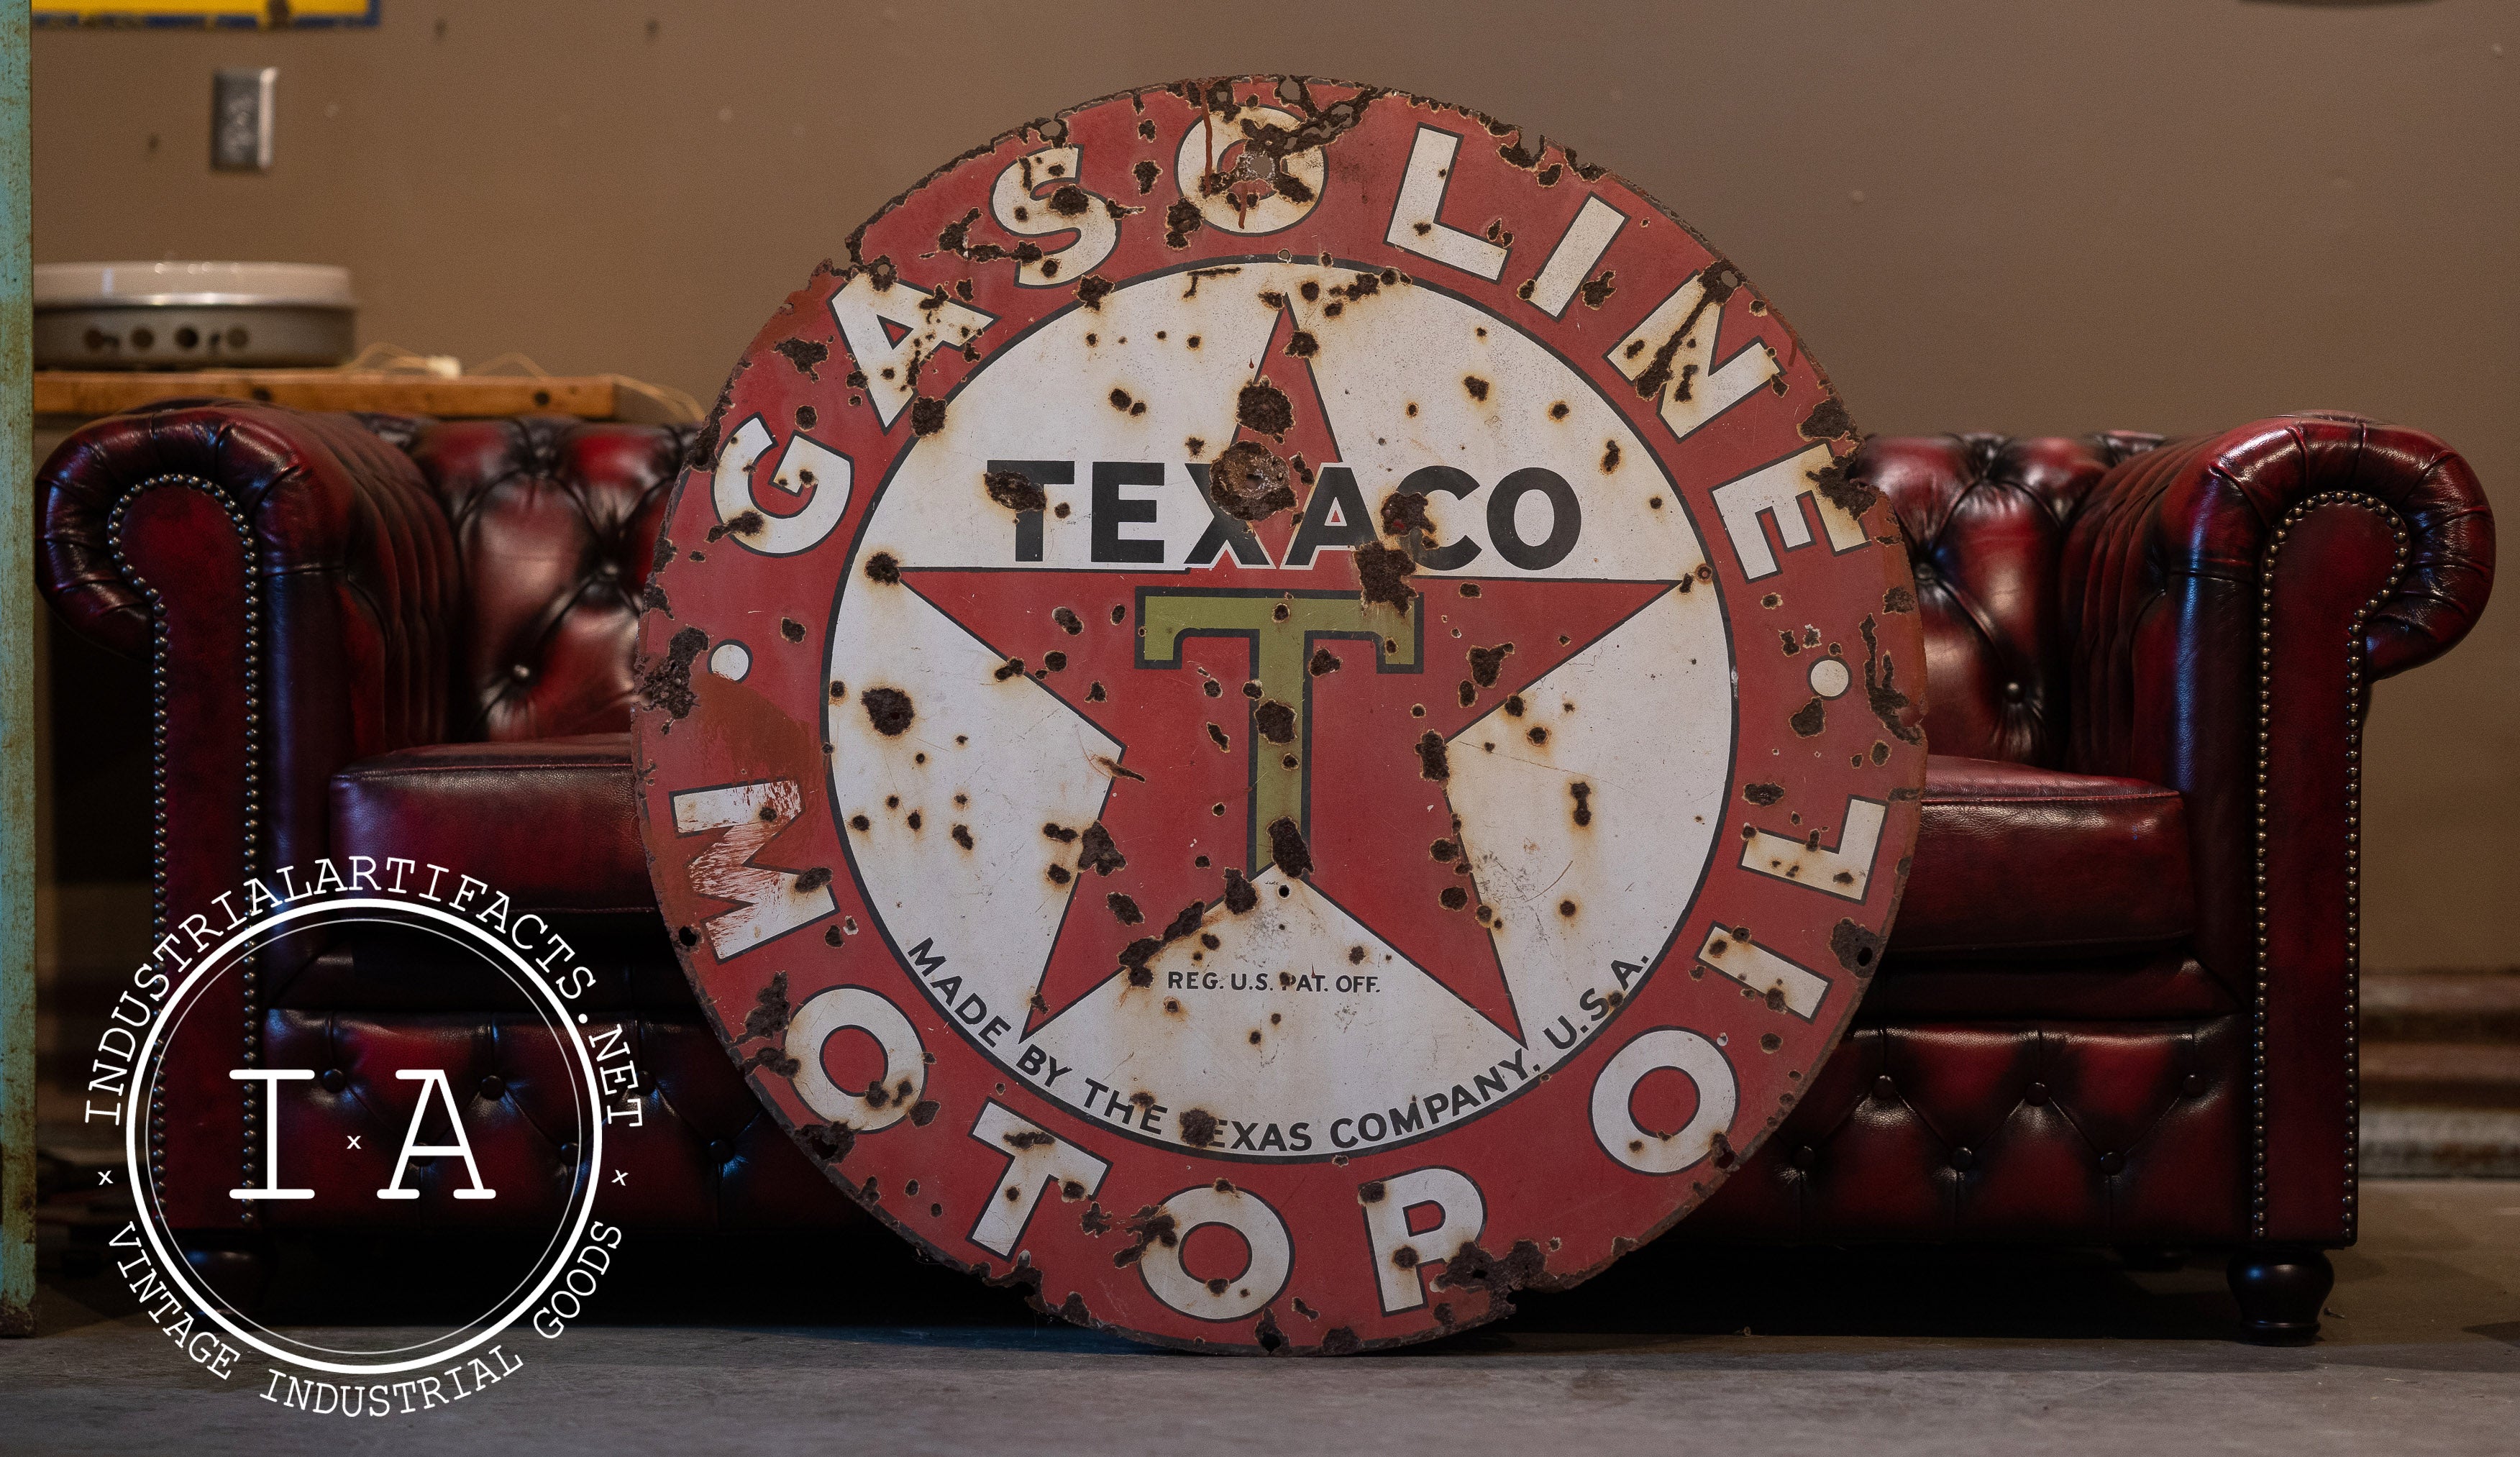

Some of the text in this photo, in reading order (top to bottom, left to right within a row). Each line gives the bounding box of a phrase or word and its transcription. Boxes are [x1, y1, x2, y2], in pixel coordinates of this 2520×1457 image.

[709, 102, 1871, 583] GASOLINE
[987, 459, 1582, 572] TEXACO
[1135, 586, 1424, 882] T
[669, 777, 1889, 1324] MOTOR OIL
[908, 936, 1012, 1049] MADE
[1015, 1043, 1072, 1087] BY
[1082, 1078, 1168, 1135] THE
[1181, 1113, 1312, 1152] EXAS
[1542, 955, 1650, 1051] U.SA.
[1168, 971, 1224, 990] REG.
[1231, 973, 1273, 992] U.S.
[1336, 975, 1381, 993] OFF.
